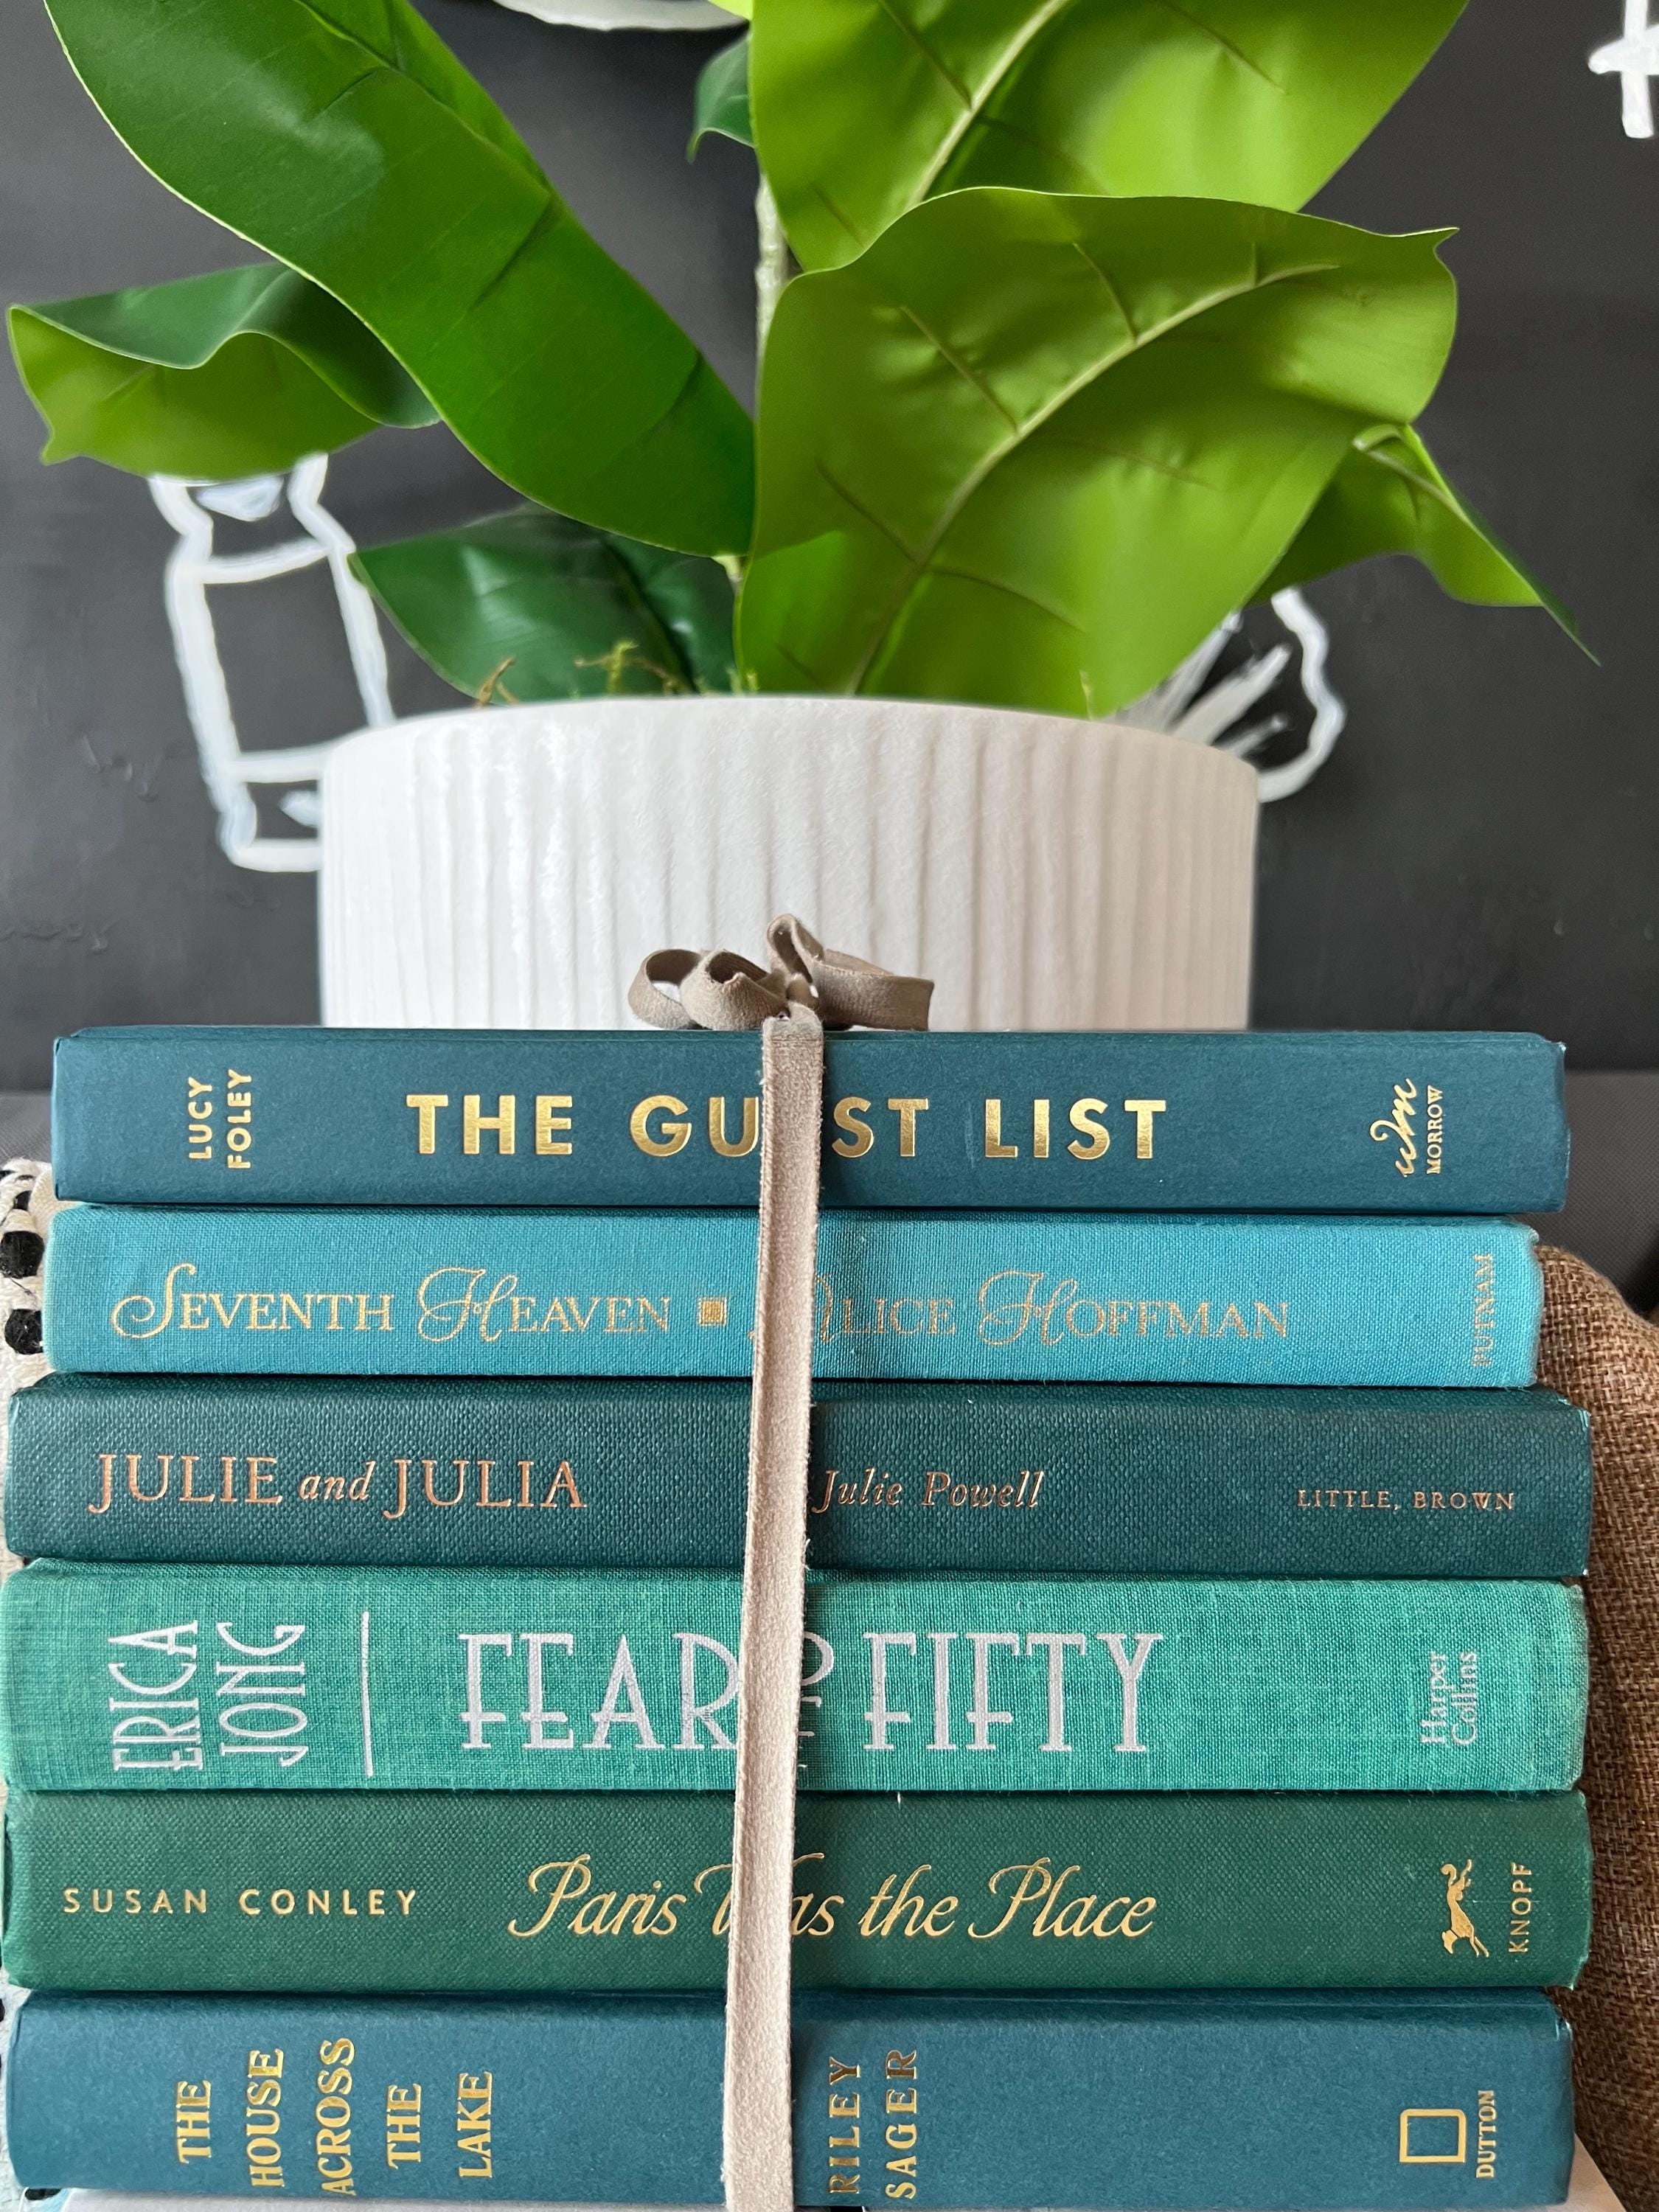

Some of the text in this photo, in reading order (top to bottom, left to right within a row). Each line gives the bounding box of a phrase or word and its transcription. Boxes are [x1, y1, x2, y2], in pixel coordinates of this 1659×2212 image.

[189, 1077, 212, 1159] LUCY
[227, 1069, 251, 1169] FOLEY
[406, 1094, 1167, 1160] THE GUST LIST
[1426, 1085, 1443, 1175] MORROW
[111, 1263, 394, 1340] SEVENTH
[417, 1267, 668, 1343] HEAVEN
[977, 1270, 1290, 1347] HOFFMAN
[1472, 1252, 1495, 1368] PUTNAM
[88, 1453, 588, 1520] JULIE and JULIA
[812, 1468, 1046, 1514] Julie Powell
[1297, 1488, 1515, 1512] LITTLE, BROWN
[108, 1619, 204, 1771] ERICA
[215, 1621, 307, 1767] JONG
[458, 1632, 738, 1751] FEAR
[863, 1631, 1164, 1753] FIFTY
[1419, 1650, 1454, 1745] Harper
[1450, 1650, 1477, 1745] Collins
[63, 1887, 416, 1916] SUSAN CONLEY
[507, 1853, 687, 1938] Paris
[858, 1863, 958, 1938] the
[967, 1857, 1157, 1939] Place
[1508, 1862, 1531, 1955] KNOPF
[175, 2080, 212, 2164] THE
[246, 2048, 285, 2188] HOUSE
[318, 2037, 355, 2197] ACROSS
[387, 2084, 422, 2168] THE
[456, 2070, 493, 2178] LAKE
[829, 2056, 861, 2194] RILEY
[886, 2049, 917, 2199] SAGER
[1476, 2090, 1496, 2178] DUTTON
